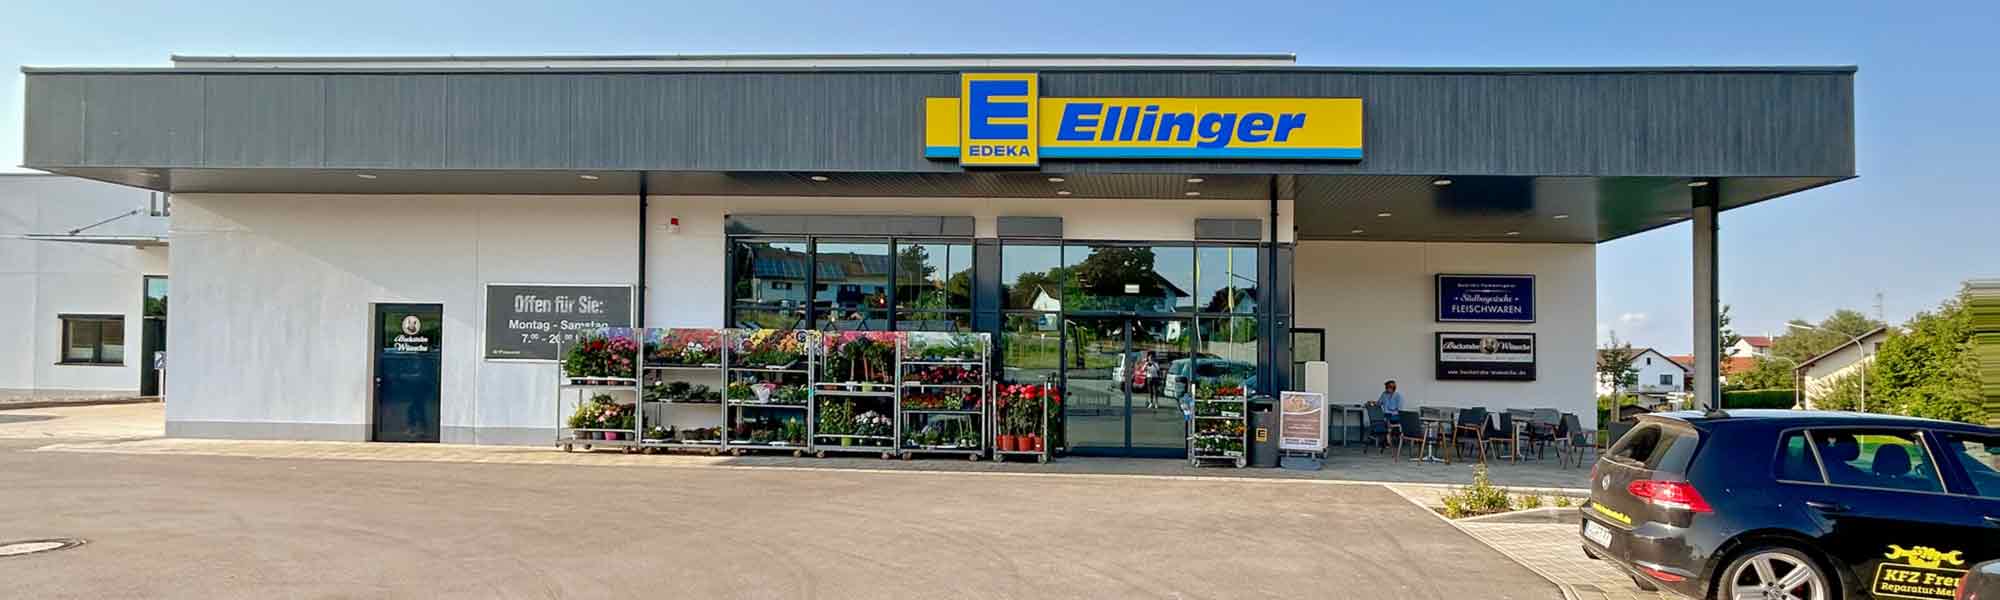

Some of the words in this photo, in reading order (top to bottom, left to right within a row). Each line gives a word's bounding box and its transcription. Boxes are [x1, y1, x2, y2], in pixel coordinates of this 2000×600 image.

[969, 80, 1028, 139] E
[1056, 102, 1306, 149] Ellinger
[969, 145, 1029, 156] EDEKA
[514, 294, 551, 313] Offen
[554, 295, 575, 313] für
[578, 295, 604, 314] Sie:
[1451, 304, 1522, 313] FLEISCHWAREN
[508, 319, 550, 331] Montag
[1884, 569, 1921, 583] KFZ
